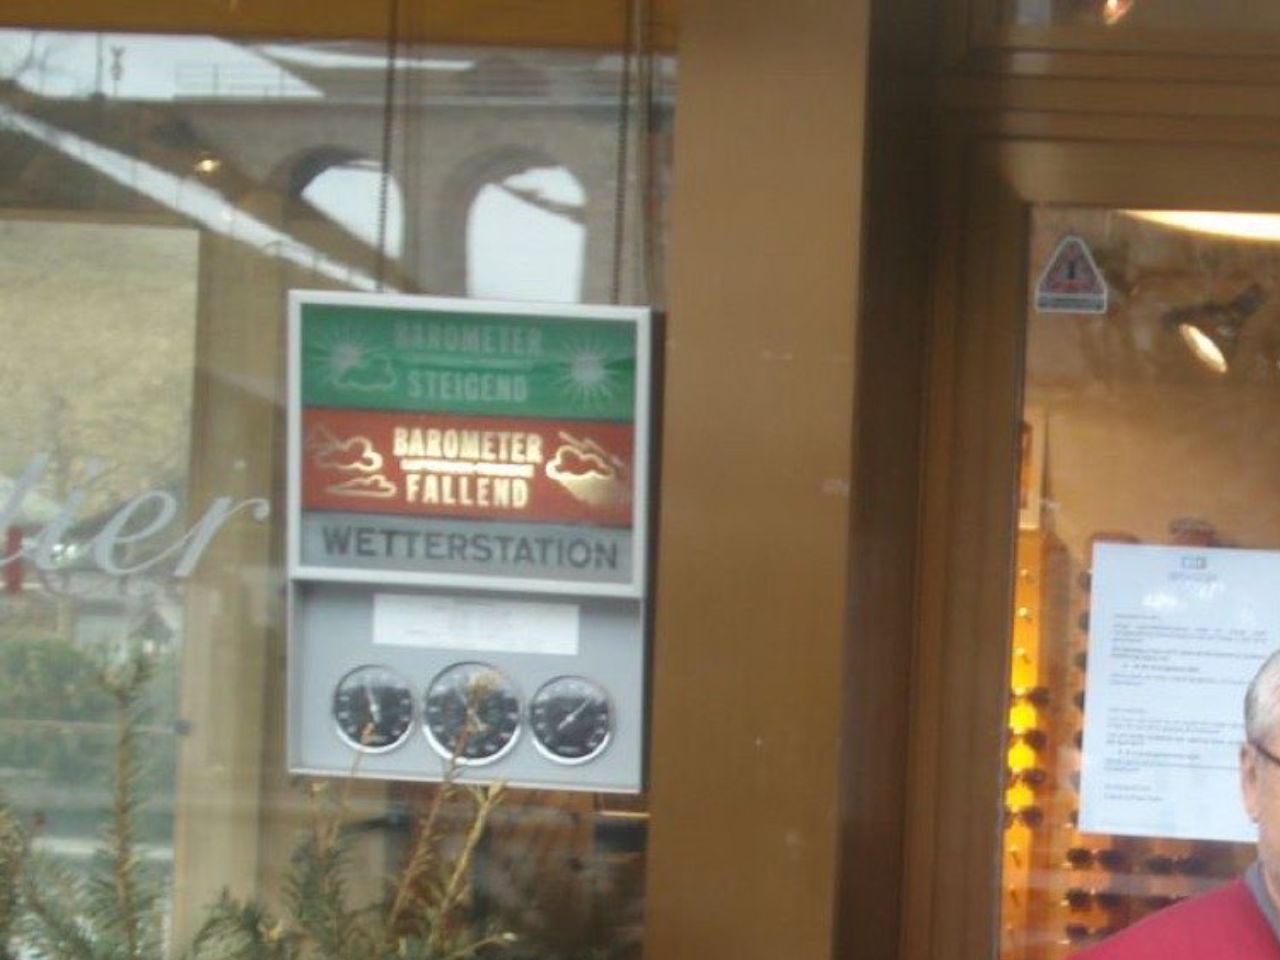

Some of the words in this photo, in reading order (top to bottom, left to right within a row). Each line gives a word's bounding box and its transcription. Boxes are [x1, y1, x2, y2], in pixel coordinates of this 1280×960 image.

[394, 322, 544, 354] BAROMETER
[407, 370, 528, 402] STEIGEND
[393, 427, 544, 464] BAROMETER
[406, 473, 529, 509] FALLEND
[322, 526, 619, 569] WETTERSTATION
